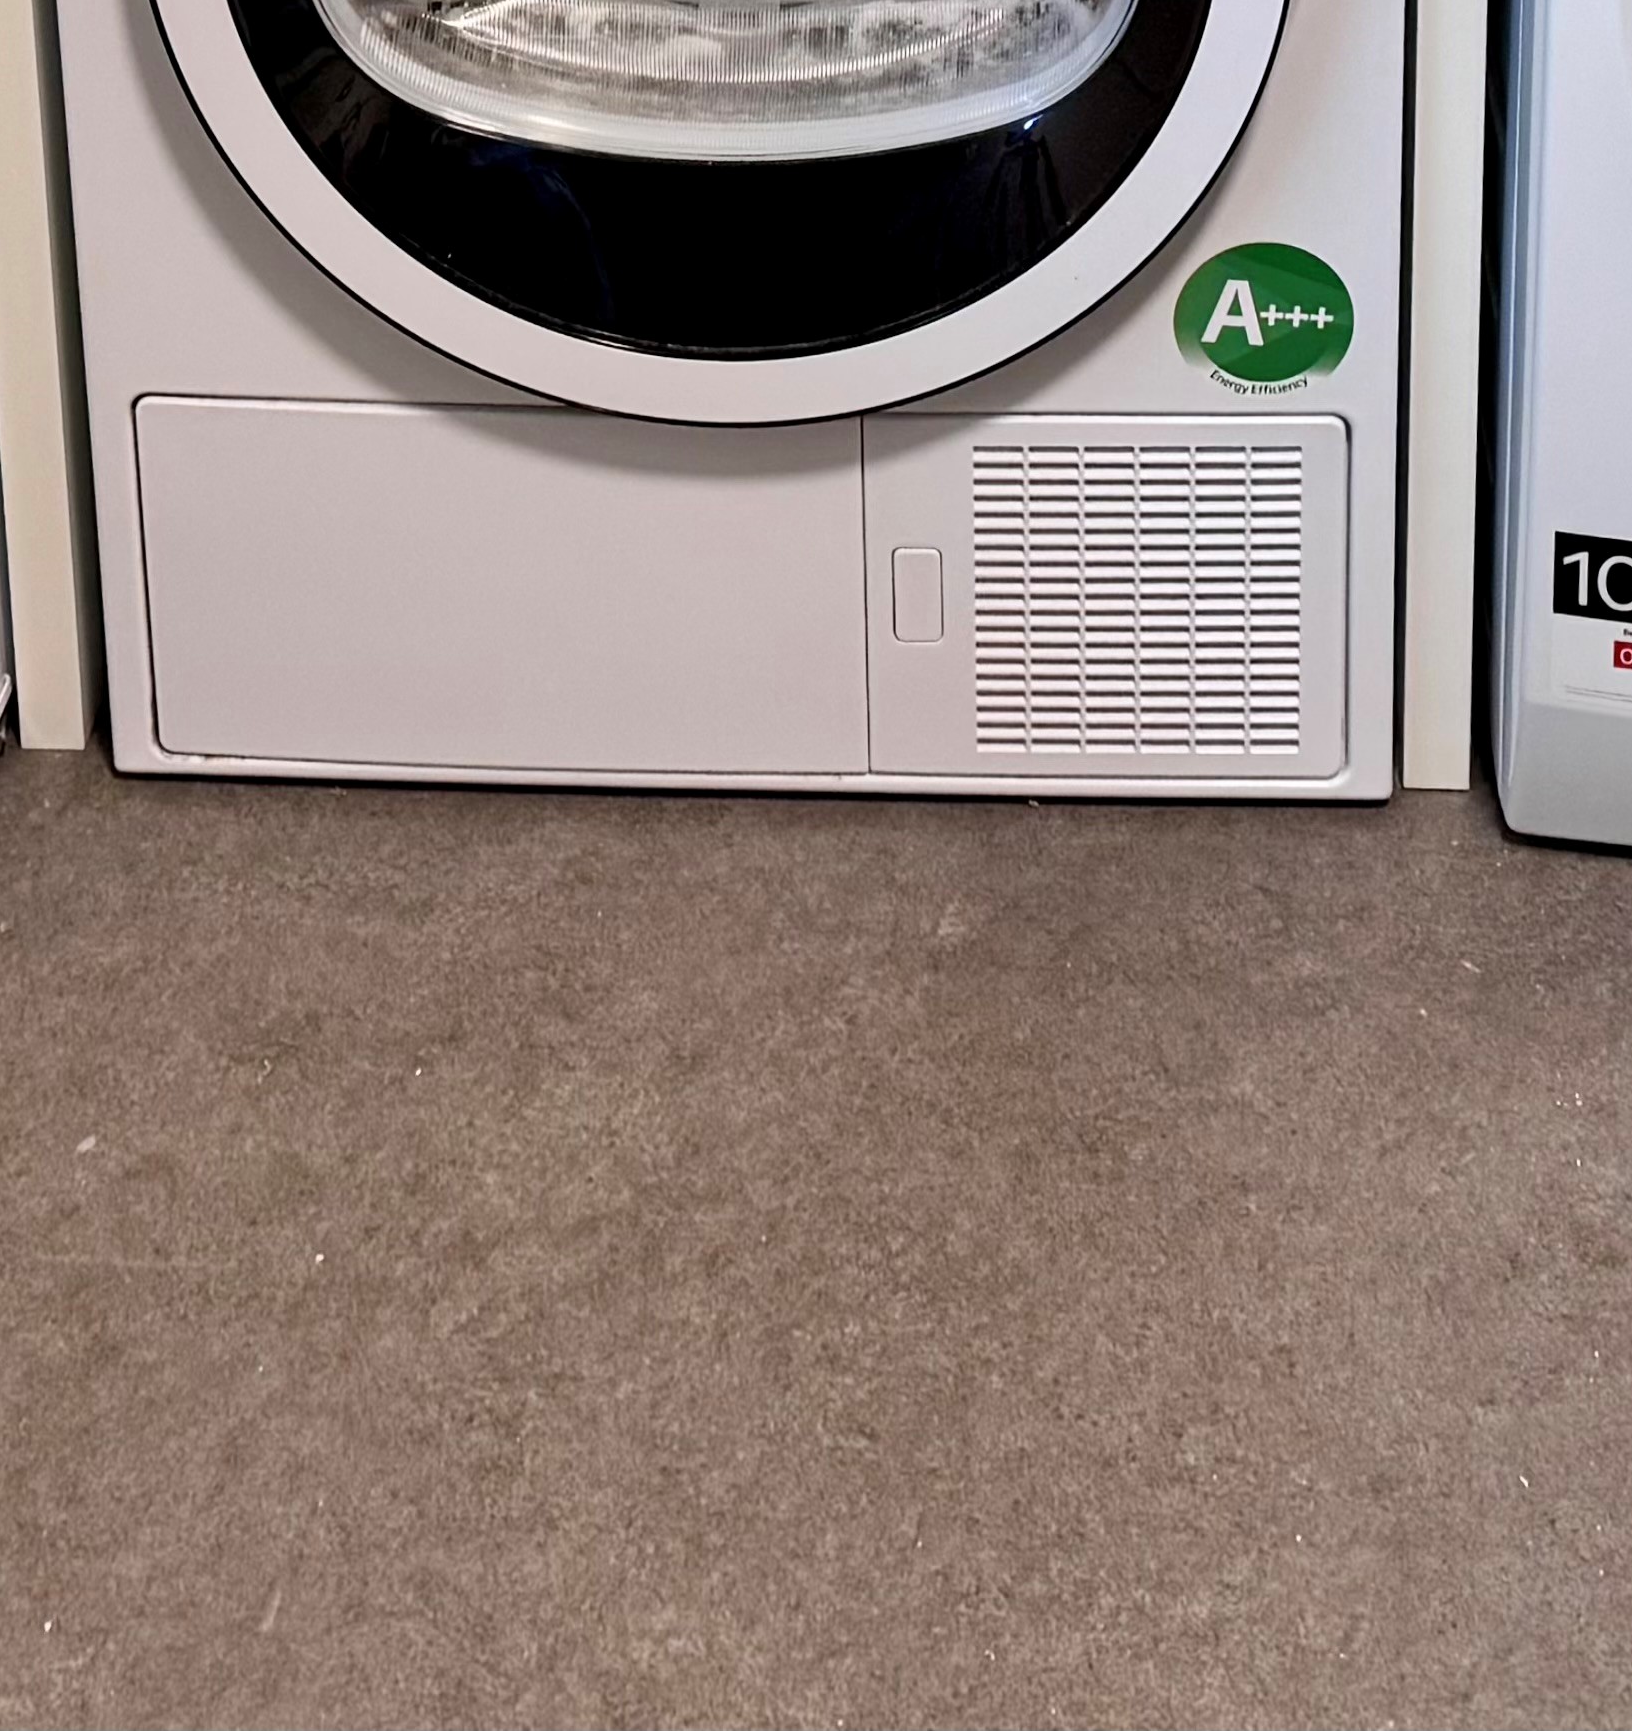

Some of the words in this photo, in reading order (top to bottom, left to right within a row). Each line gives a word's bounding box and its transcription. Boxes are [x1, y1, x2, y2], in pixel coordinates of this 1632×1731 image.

[1200, 279, 1334, 347] A+++
[1210, 369, 1249, 395] Energy
[1251, 375, 1308, 395] Efficiency
